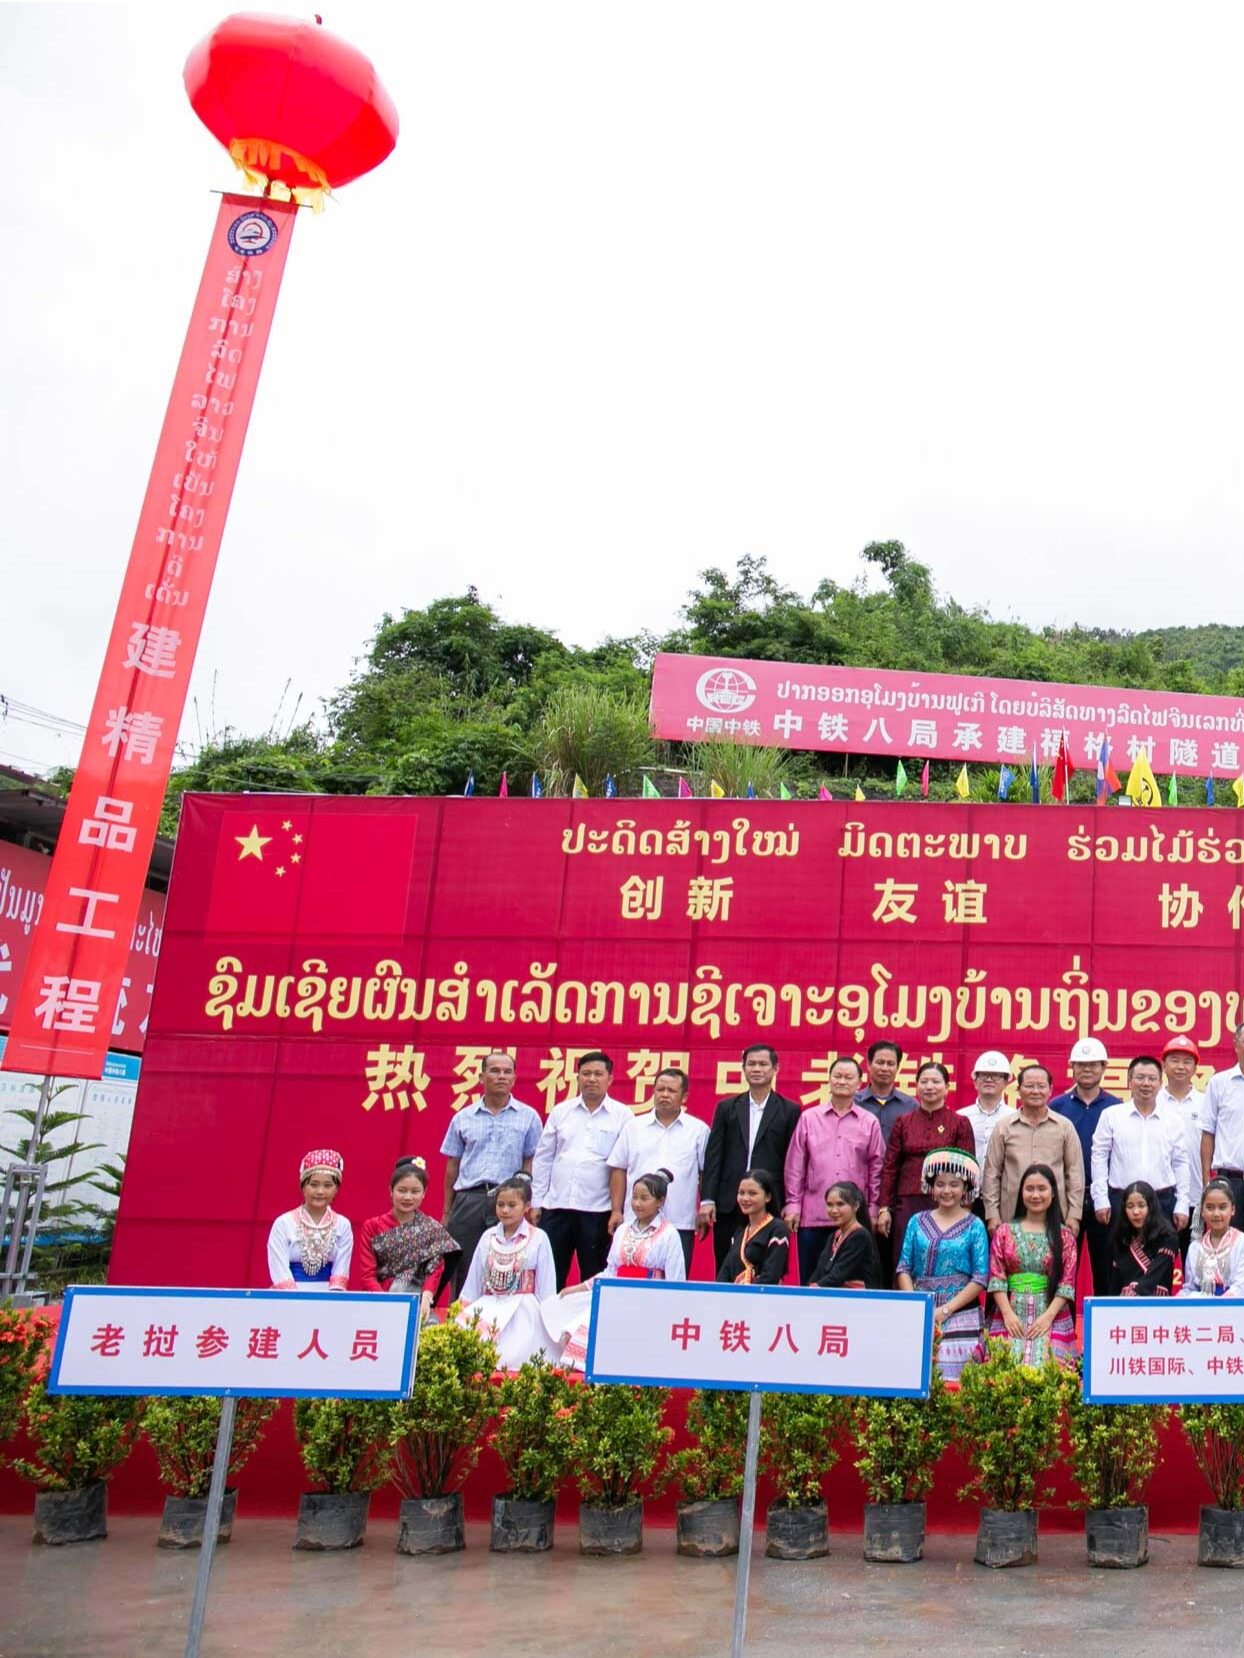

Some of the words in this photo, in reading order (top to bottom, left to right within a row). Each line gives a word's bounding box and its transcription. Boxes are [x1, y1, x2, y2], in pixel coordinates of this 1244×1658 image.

[686, 716, 761, 736] 中国中铁
[34, 620, 183, 1035] 建精品工程
[619, 875, 734, 921] 创新
[872, 877, 988, 924] 友谊
[91, 1323, 379, 1361] 老挝参建人员
[671, 1317, 849, 1358] 中铁八局
